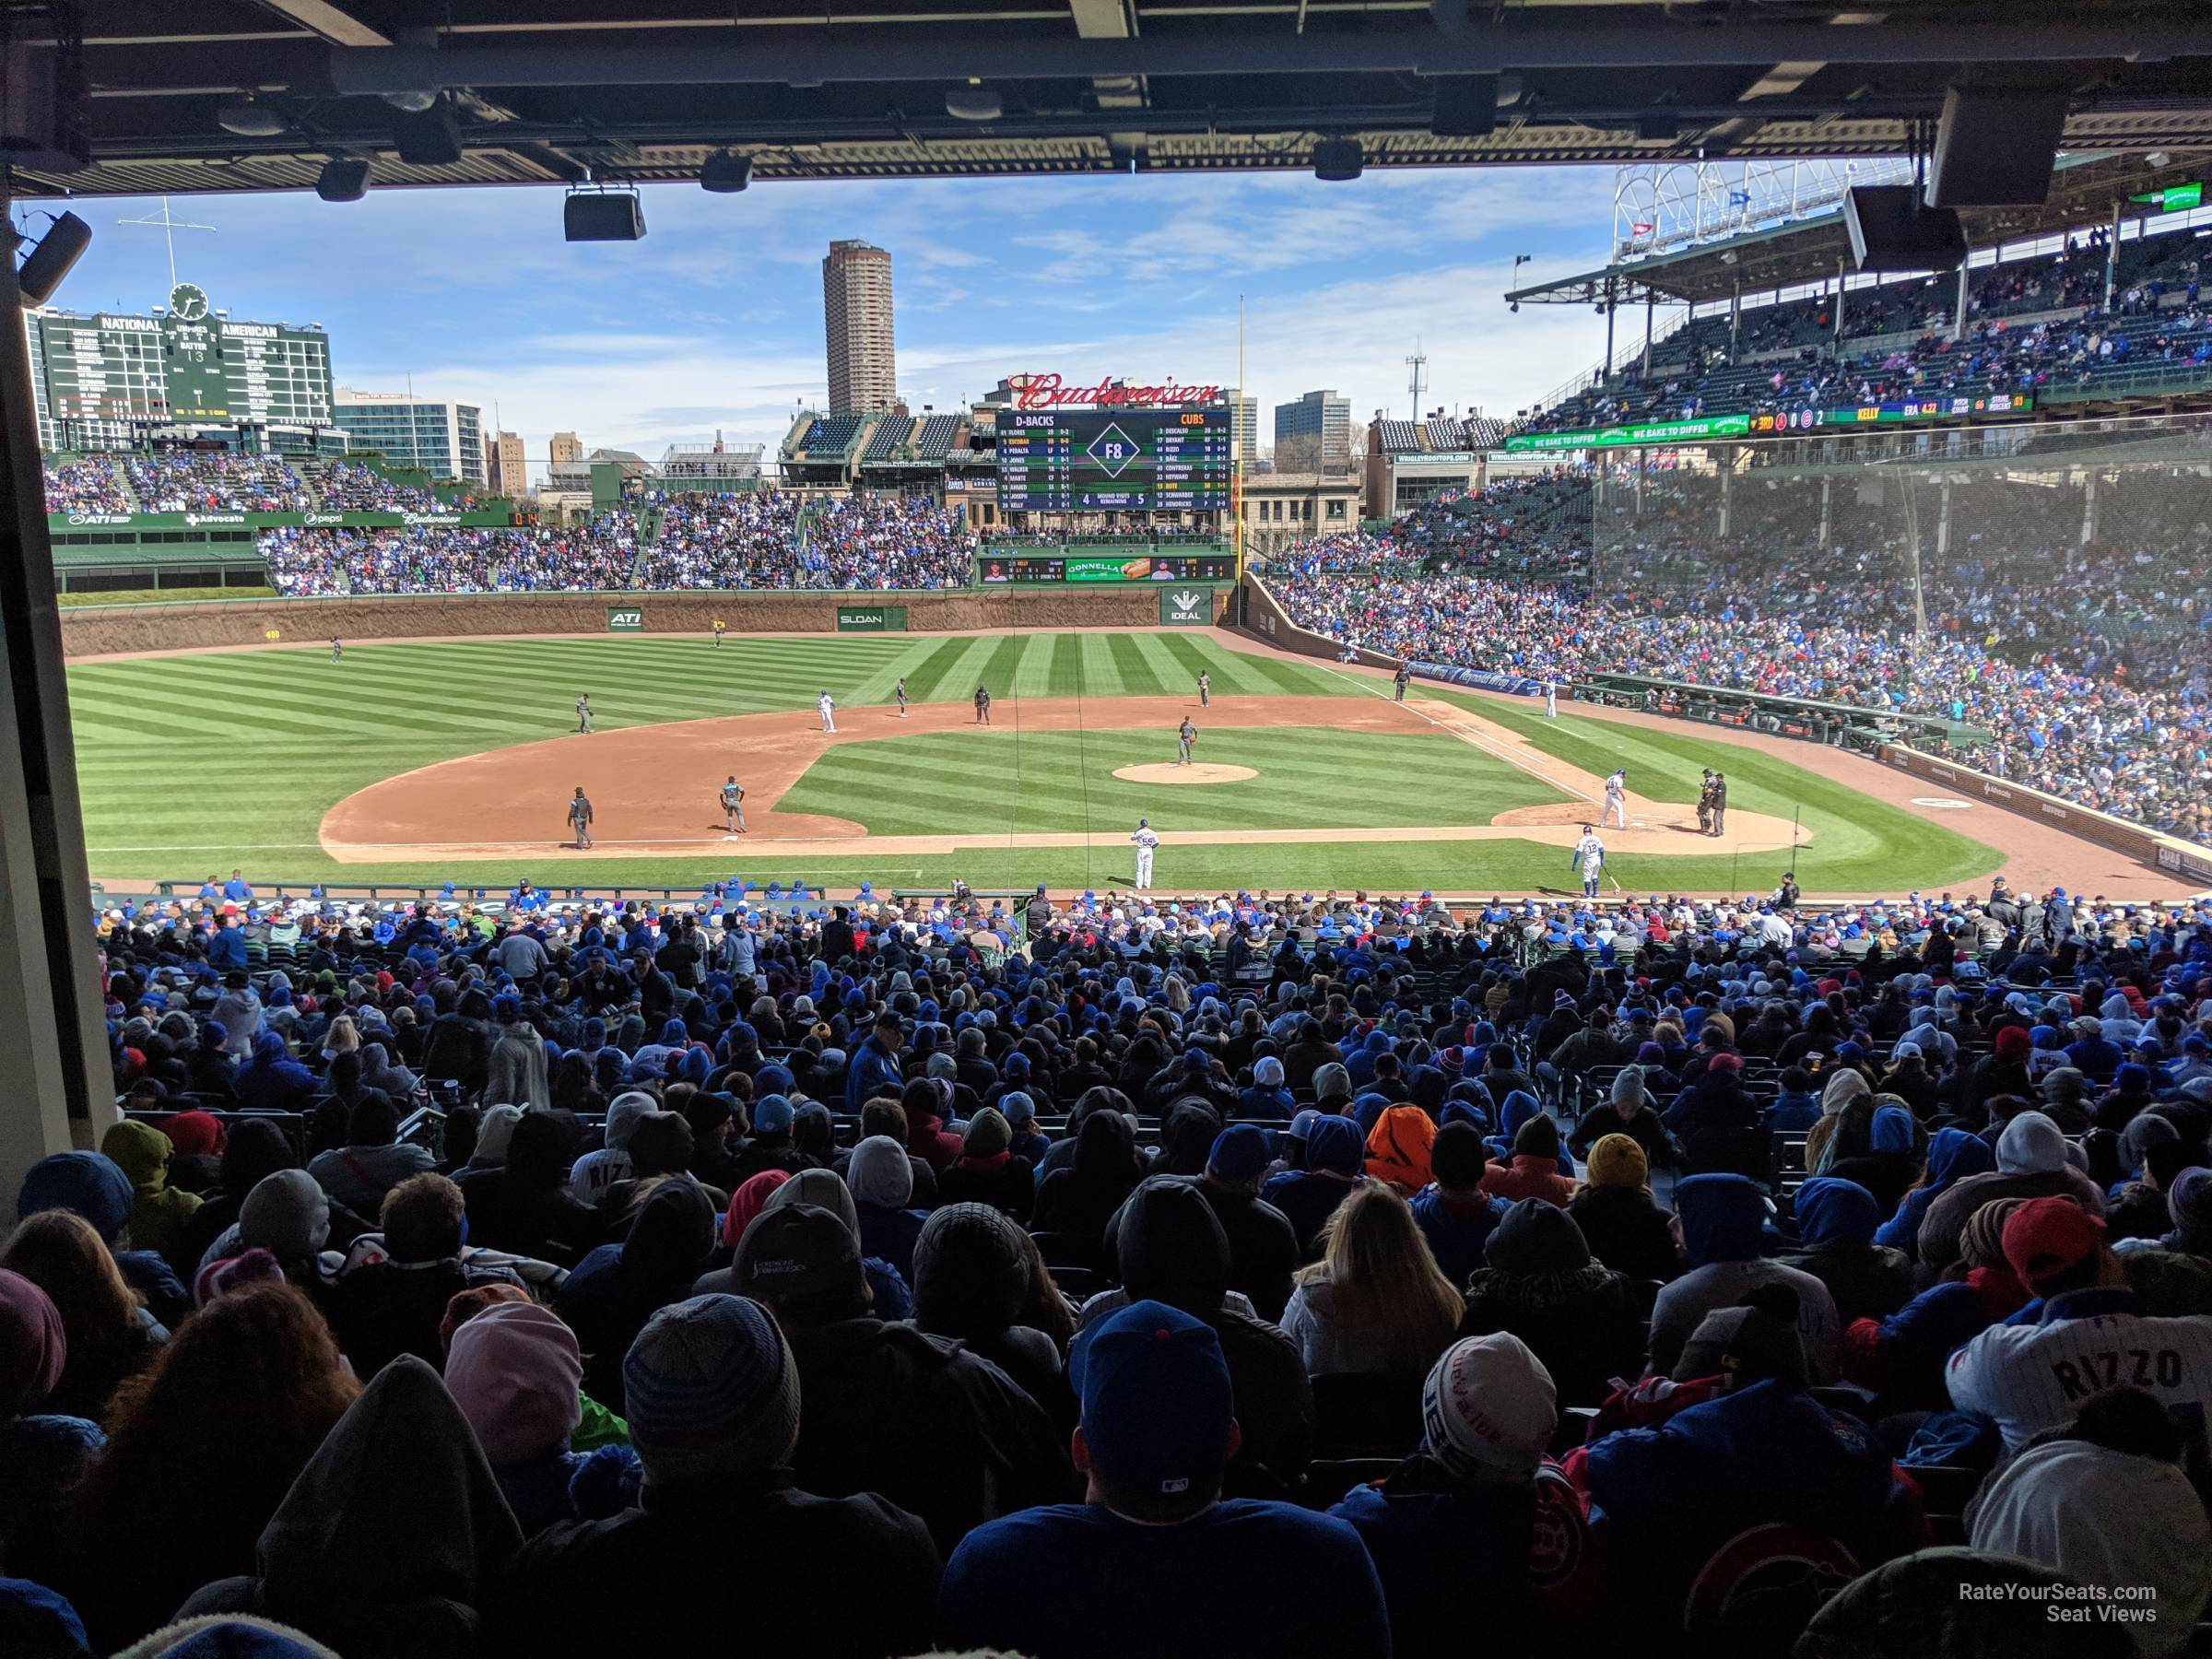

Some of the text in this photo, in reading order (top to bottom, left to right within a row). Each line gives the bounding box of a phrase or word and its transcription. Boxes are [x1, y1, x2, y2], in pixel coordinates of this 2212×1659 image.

[101, 317, 162, 332] NATIONAL
[176, 324, 208, 334] UMPIRES
[221, 324, 277, 338] AMERICAN
[180, 341, 207, 351] BATTER
[188, 350, 204, 362] 13
[1008, 372, 1219, 409] Budweiser
[1904, 405, 1917, 416] ERA
[1988, 402, 2011, 411] PERCENT
[1816, 410, 1823, 426] 2
[1858, 407, 1879, 420] KELLY
[1016, 416, 1054, 427] D-BACKS
[1181, 414, 1205, 425] CUBS
[1714, 418, 1747, 429] GONNELLA
[1759, 416, 1773, 429] 3RD
[1790, 413, 1796, 428] 0
[1633, 424, 1709, 439] WE BAKE TO DIFFER
[1572, 435, 1596, 443] DIFFER
[1106, 443, 1123, 459] F8
[1083, 494, 1089, 504] 4
[1137, 494, 1144, 504] 5
[317, 514, 343, 524] pepsi
[402, 512, 460, 524] Budweiser
[611, 614, 641, 623] ATI
[840, 616, 882, 624] SLOAN
[265, 630, 280, 639] 400
[1460, 669, 1510, 689] Reynolds Wrap
[1143, 838, 1153, 846] 55
[1588, 844, 1596, 853] 12
[2159, 848, 2181, 865] CUBS
[2050, 1349, 2183, 1402] RIZZO
